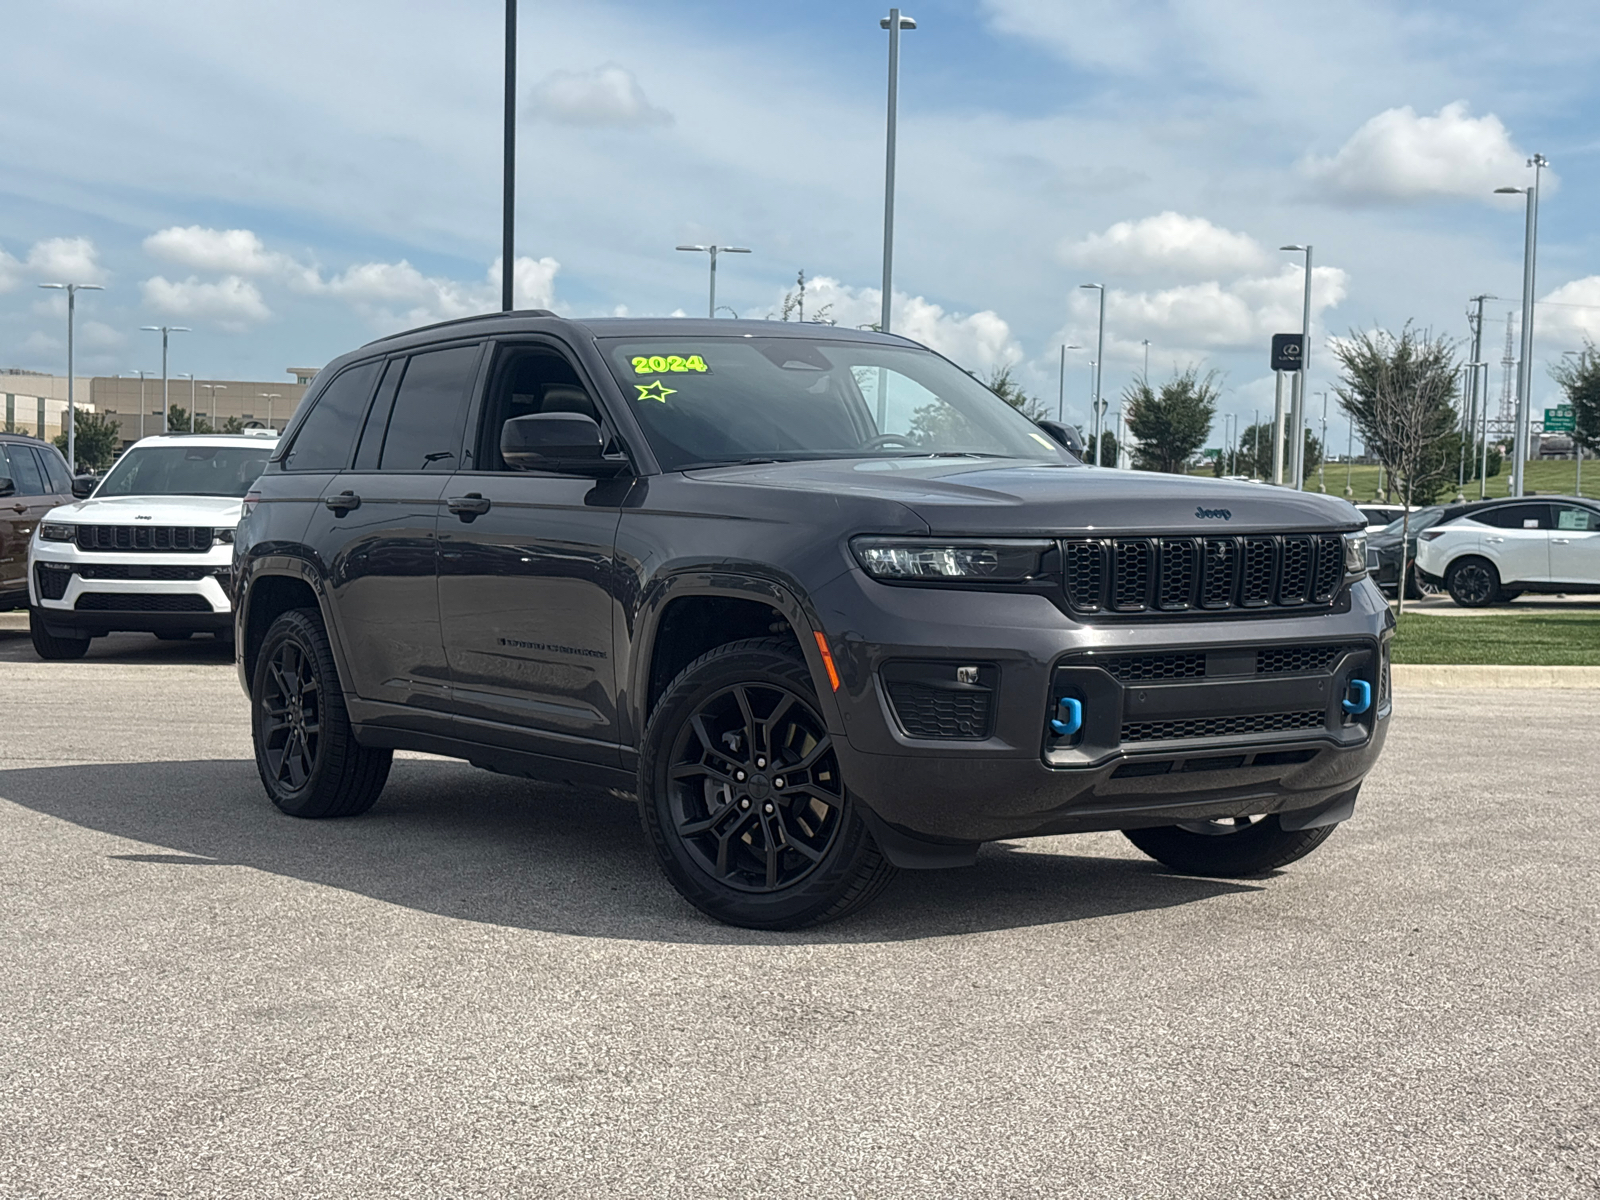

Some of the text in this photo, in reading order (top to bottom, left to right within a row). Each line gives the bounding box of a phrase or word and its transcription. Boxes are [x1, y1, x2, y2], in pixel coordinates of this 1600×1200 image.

[631, 355, 708, 374] 2024
[1195, 506, 1231, 521] Jeep
[644, 744, 672, 861] COOPER
